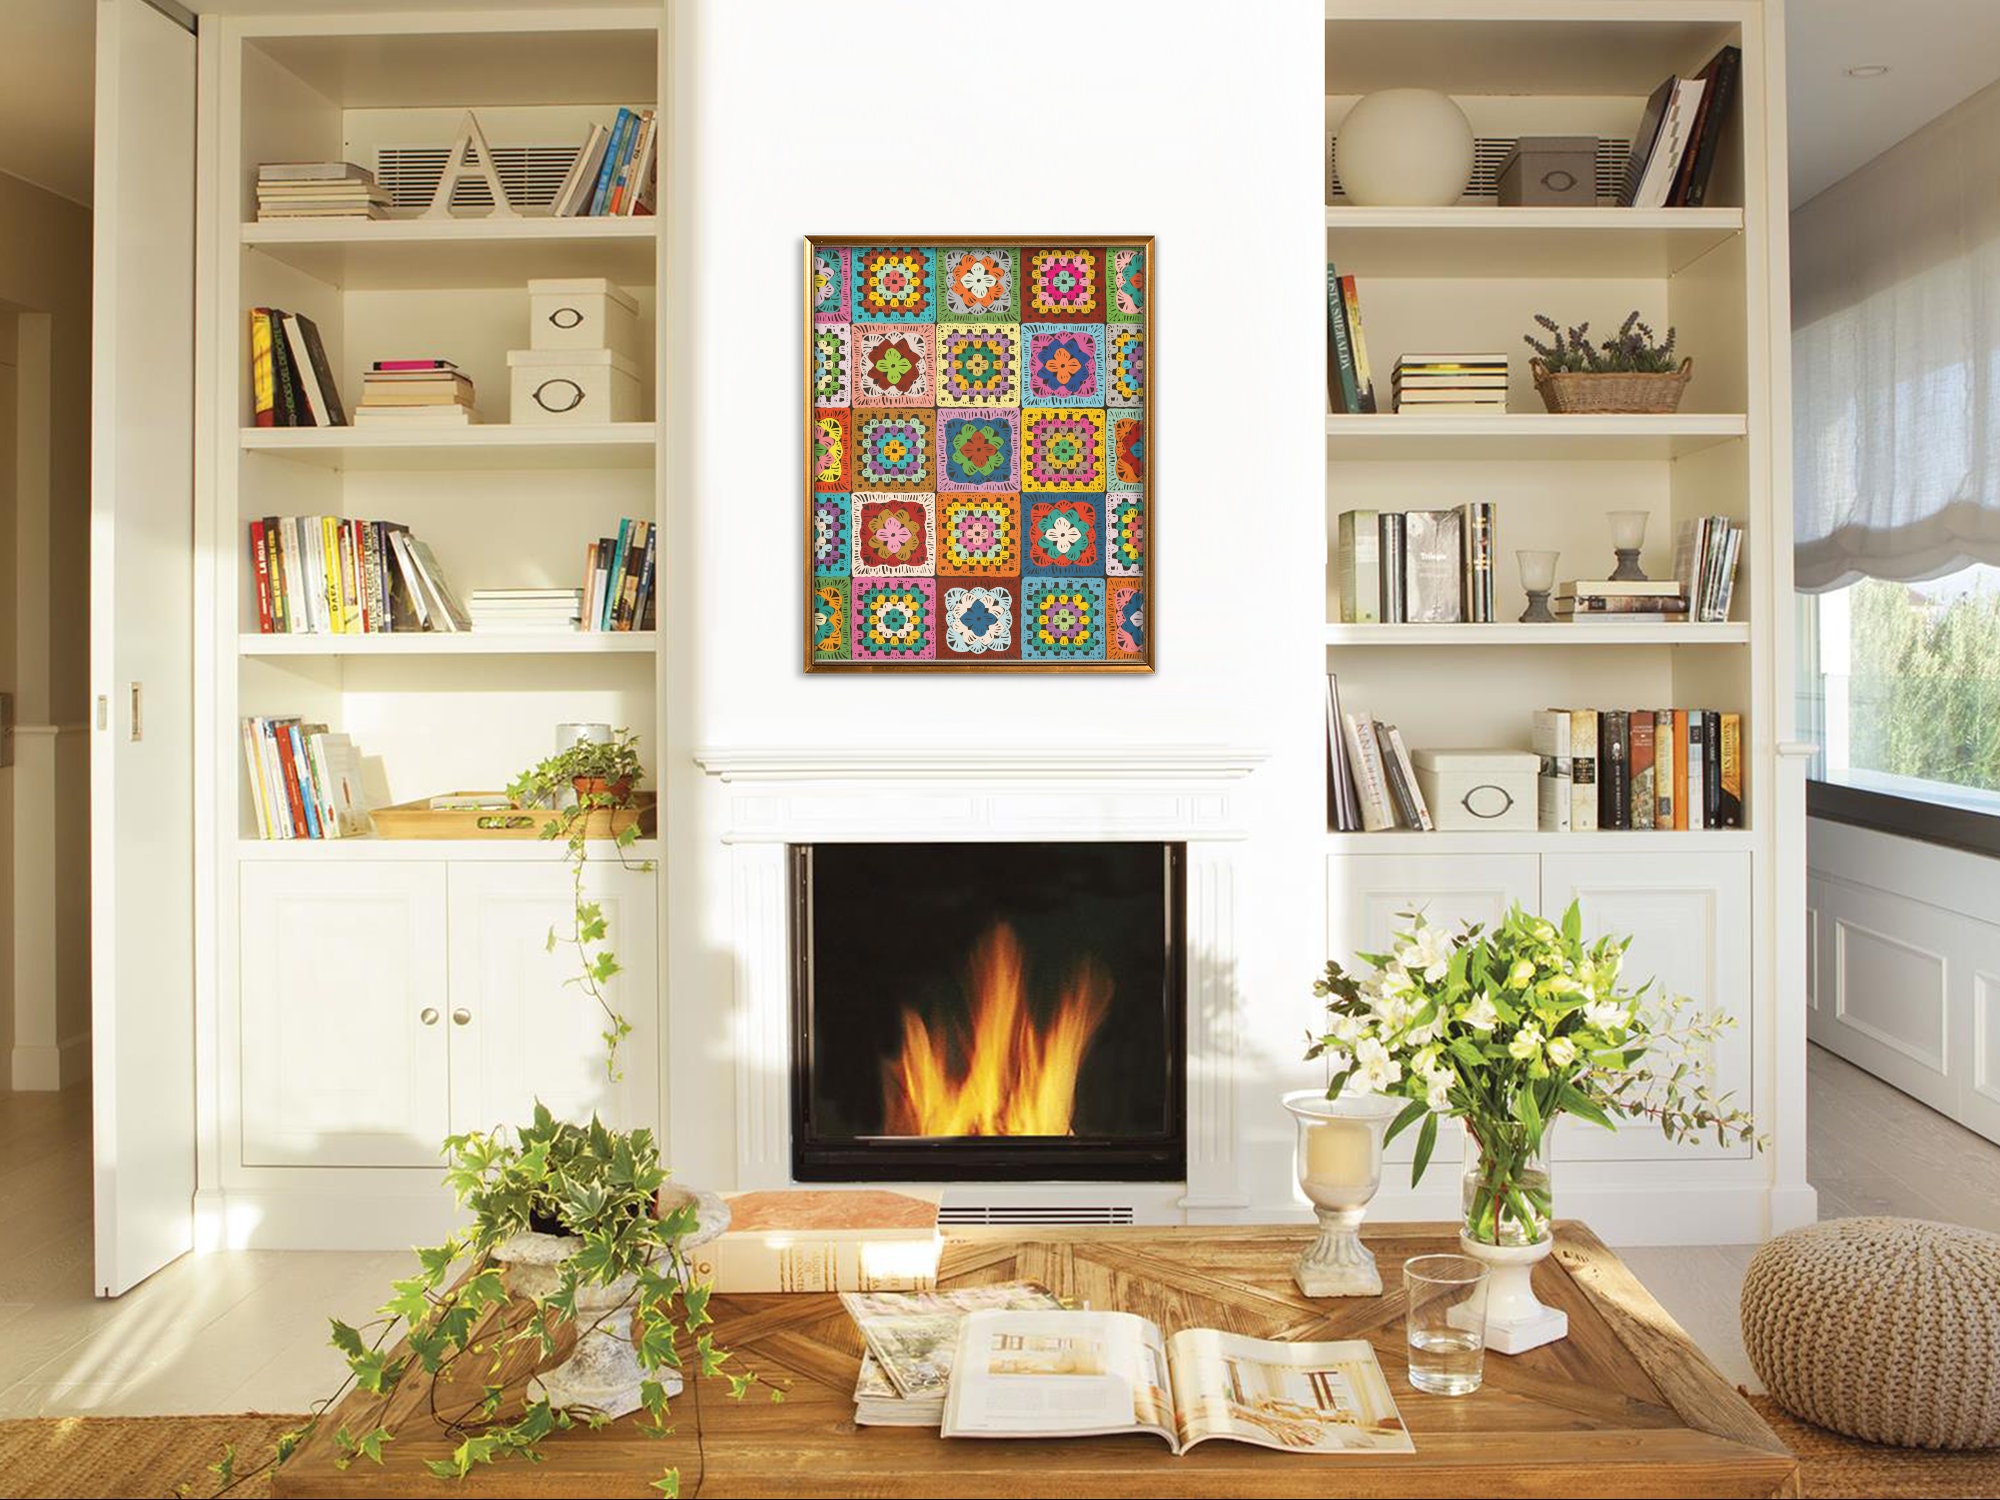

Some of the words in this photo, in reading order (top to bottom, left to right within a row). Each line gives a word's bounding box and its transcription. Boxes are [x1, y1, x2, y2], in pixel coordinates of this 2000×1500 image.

[419, 109, 523, 218] A
[1332, 306, 1351, 370] SMERALDA
[257, 540, 266, 561] ROJA
[258, 561, 267, 574] LA
